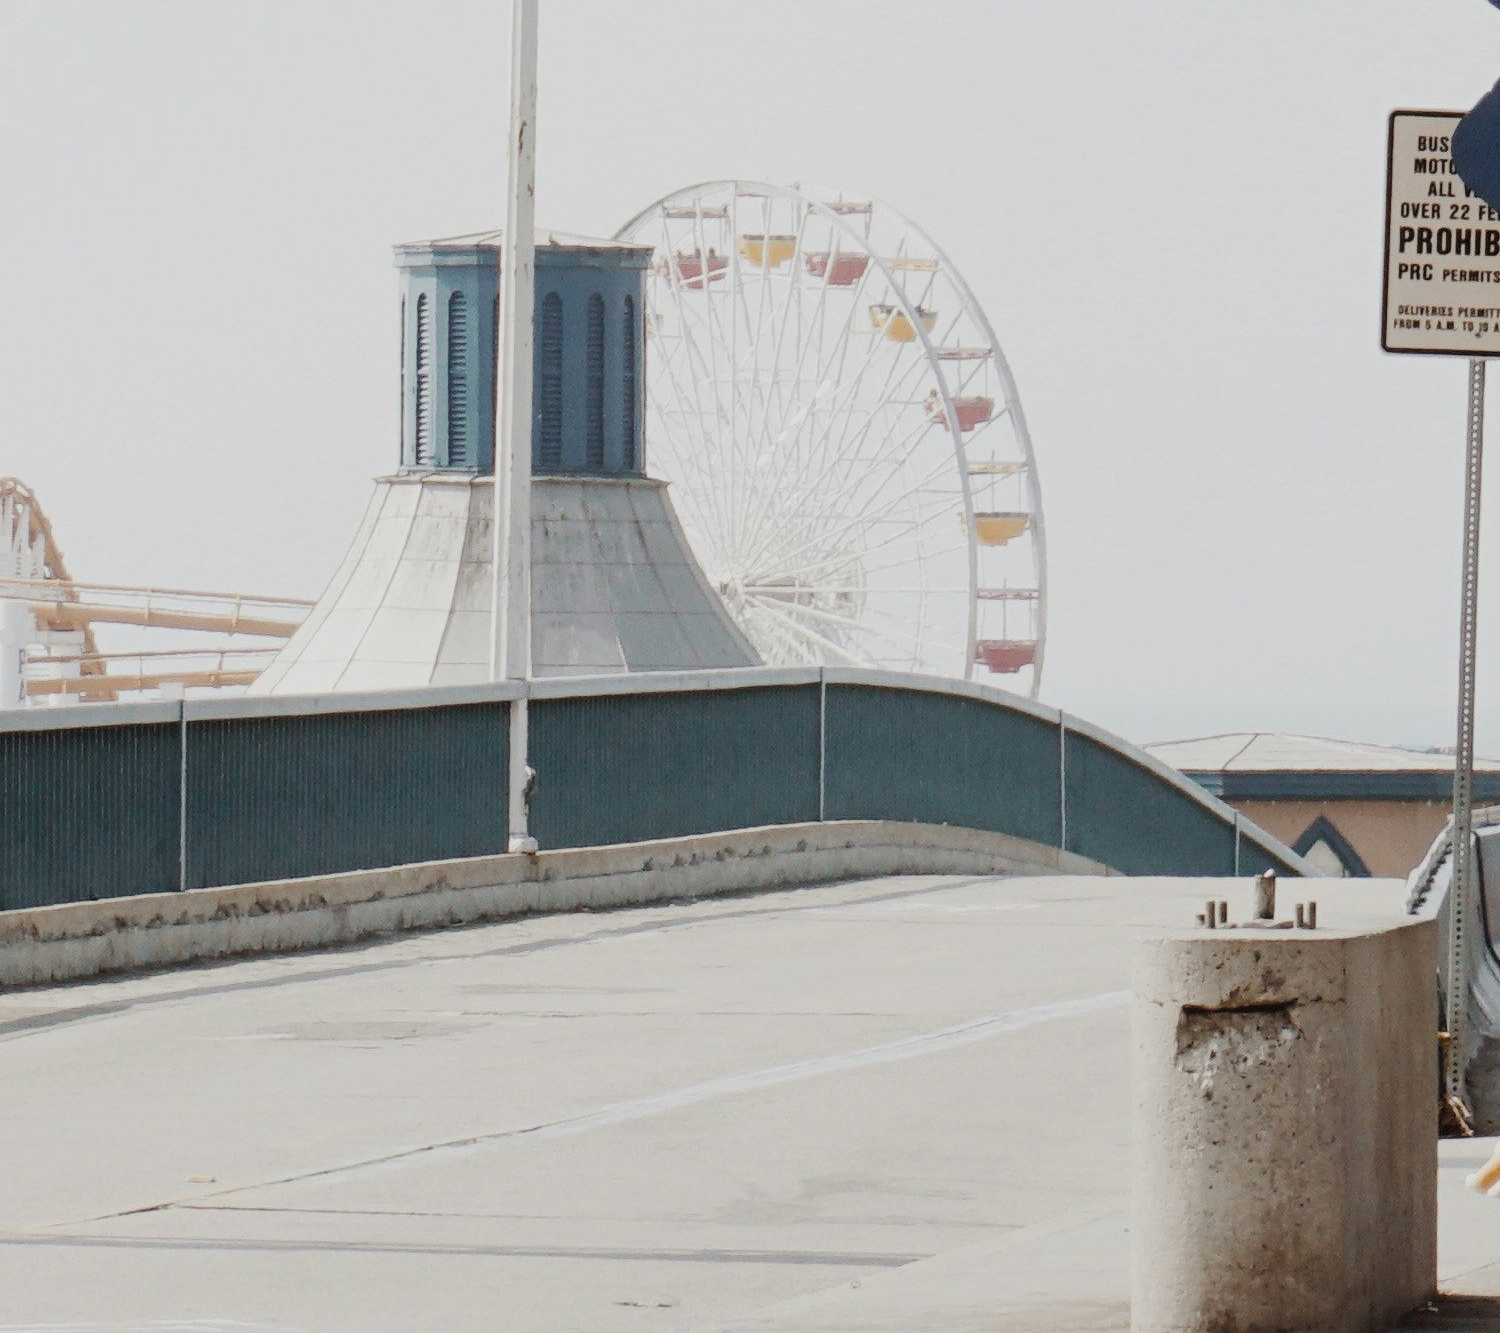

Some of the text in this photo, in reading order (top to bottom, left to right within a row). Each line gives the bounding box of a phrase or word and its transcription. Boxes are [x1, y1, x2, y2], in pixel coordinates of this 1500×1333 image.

[1427, 180, 1456, 198] ALL
[1400, 202, 1441, 219] OVER
[1450, 204, 1471, 221] 22
[1398, 262, 1434, 281] PRC
[1397, 304, 1453, 317] DELIVERIES
[1393, 318, 1420, 330] FROM
[1462, 321, 1474, 332] TO
